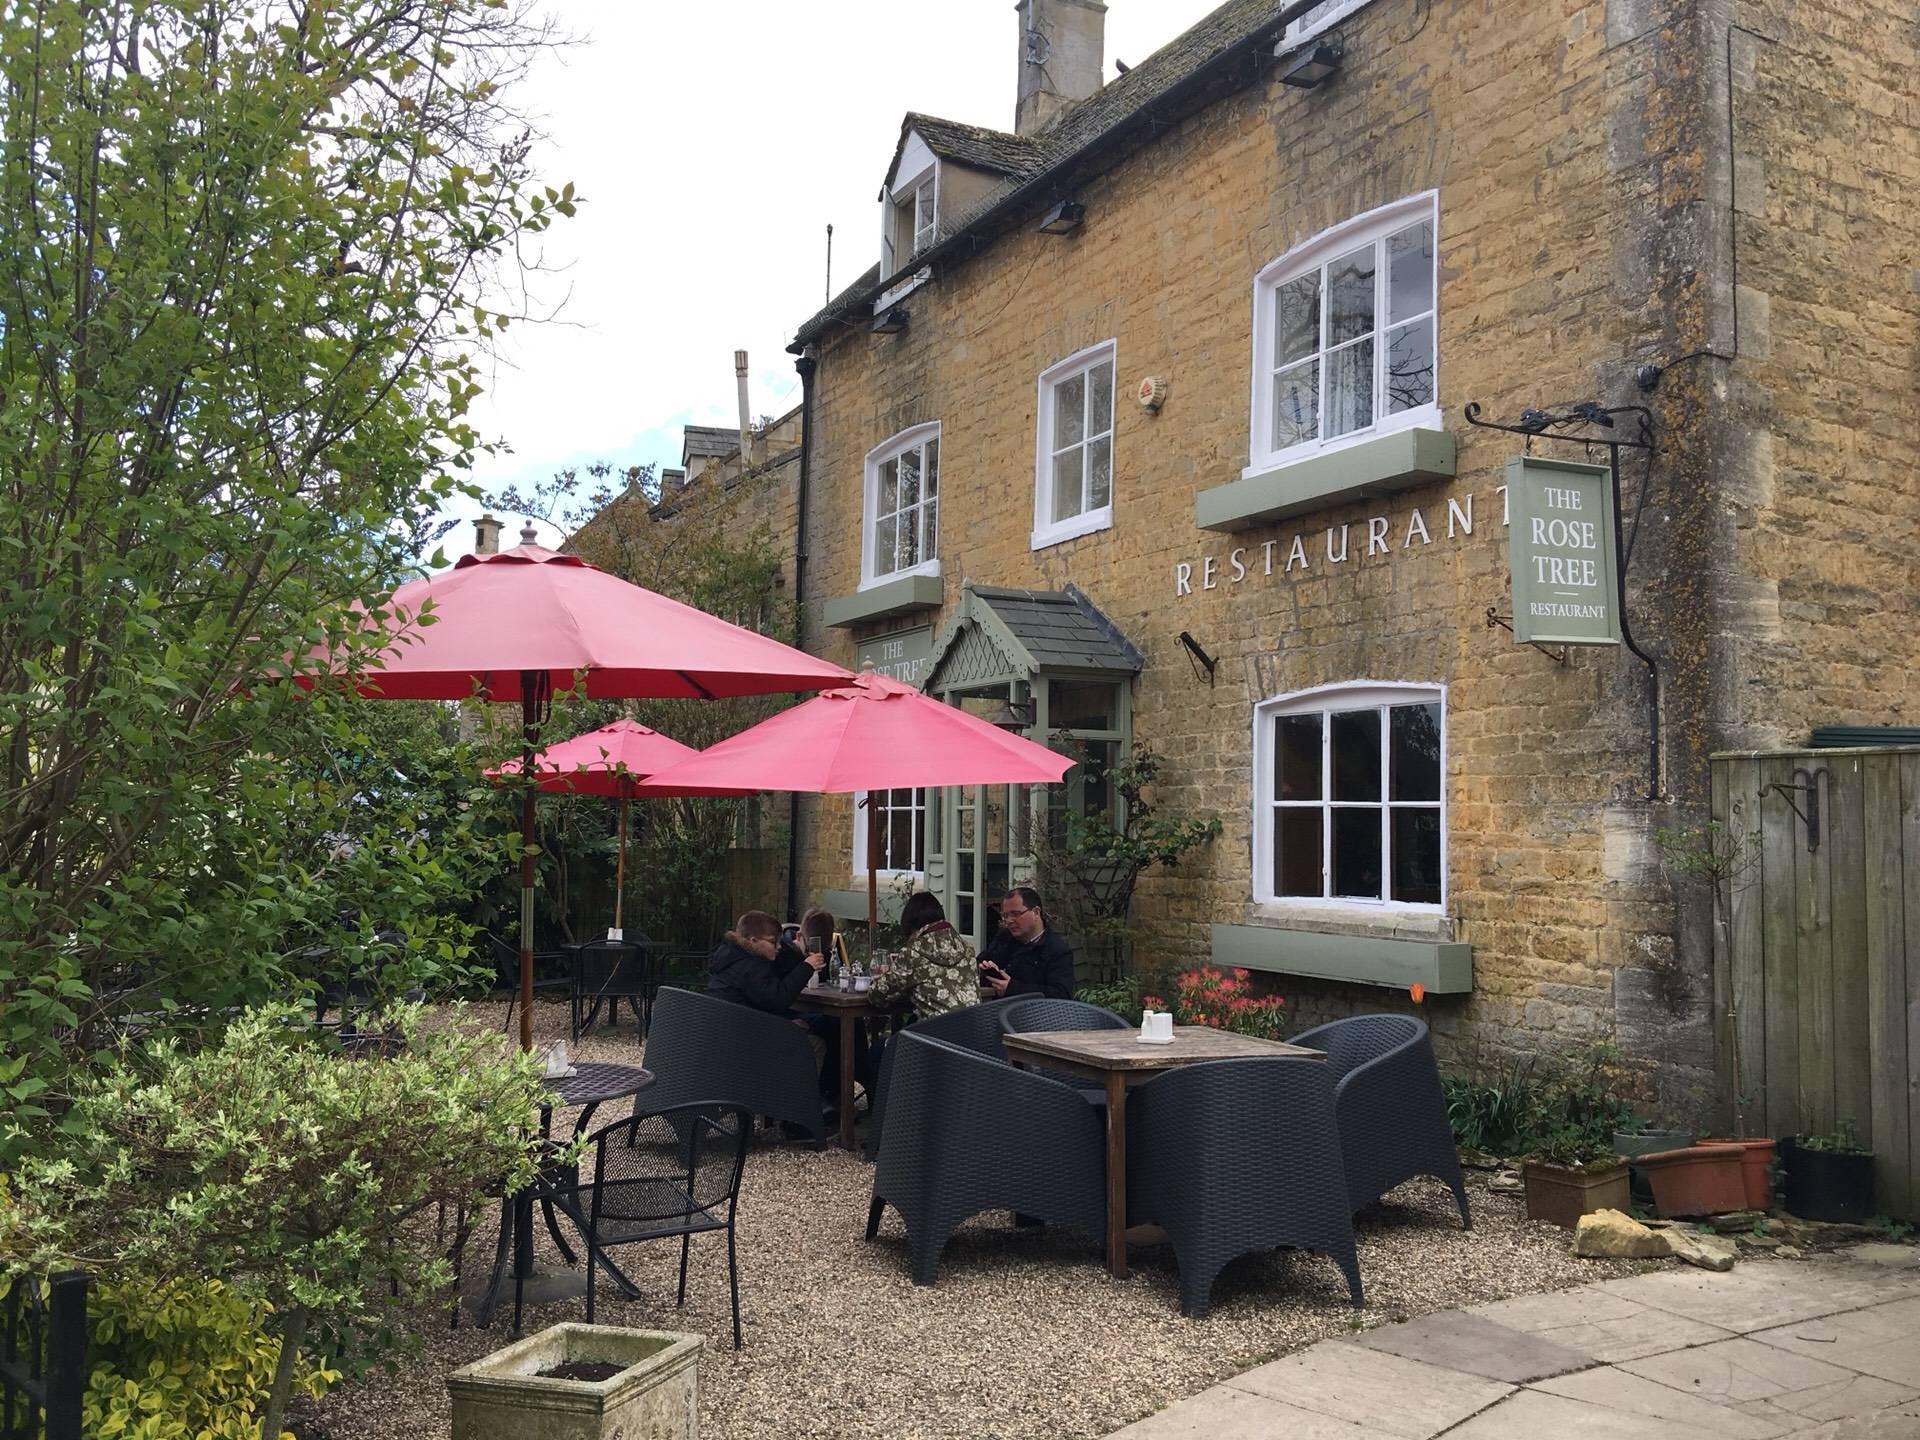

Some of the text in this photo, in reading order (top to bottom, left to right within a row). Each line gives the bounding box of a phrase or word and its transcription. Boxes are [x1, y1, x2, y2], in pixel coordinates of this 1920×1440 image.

[1544, 487, 1582, 511] THE
[1176, 485, 1510, 597] RESTAURANT
[1531, 517, 1596, 549] ROSE
[1532, 555, 1597, 586] TREE
[1530, 602, 1605, 618] RESTAURANT
[883, 641, 904, 660] THE
